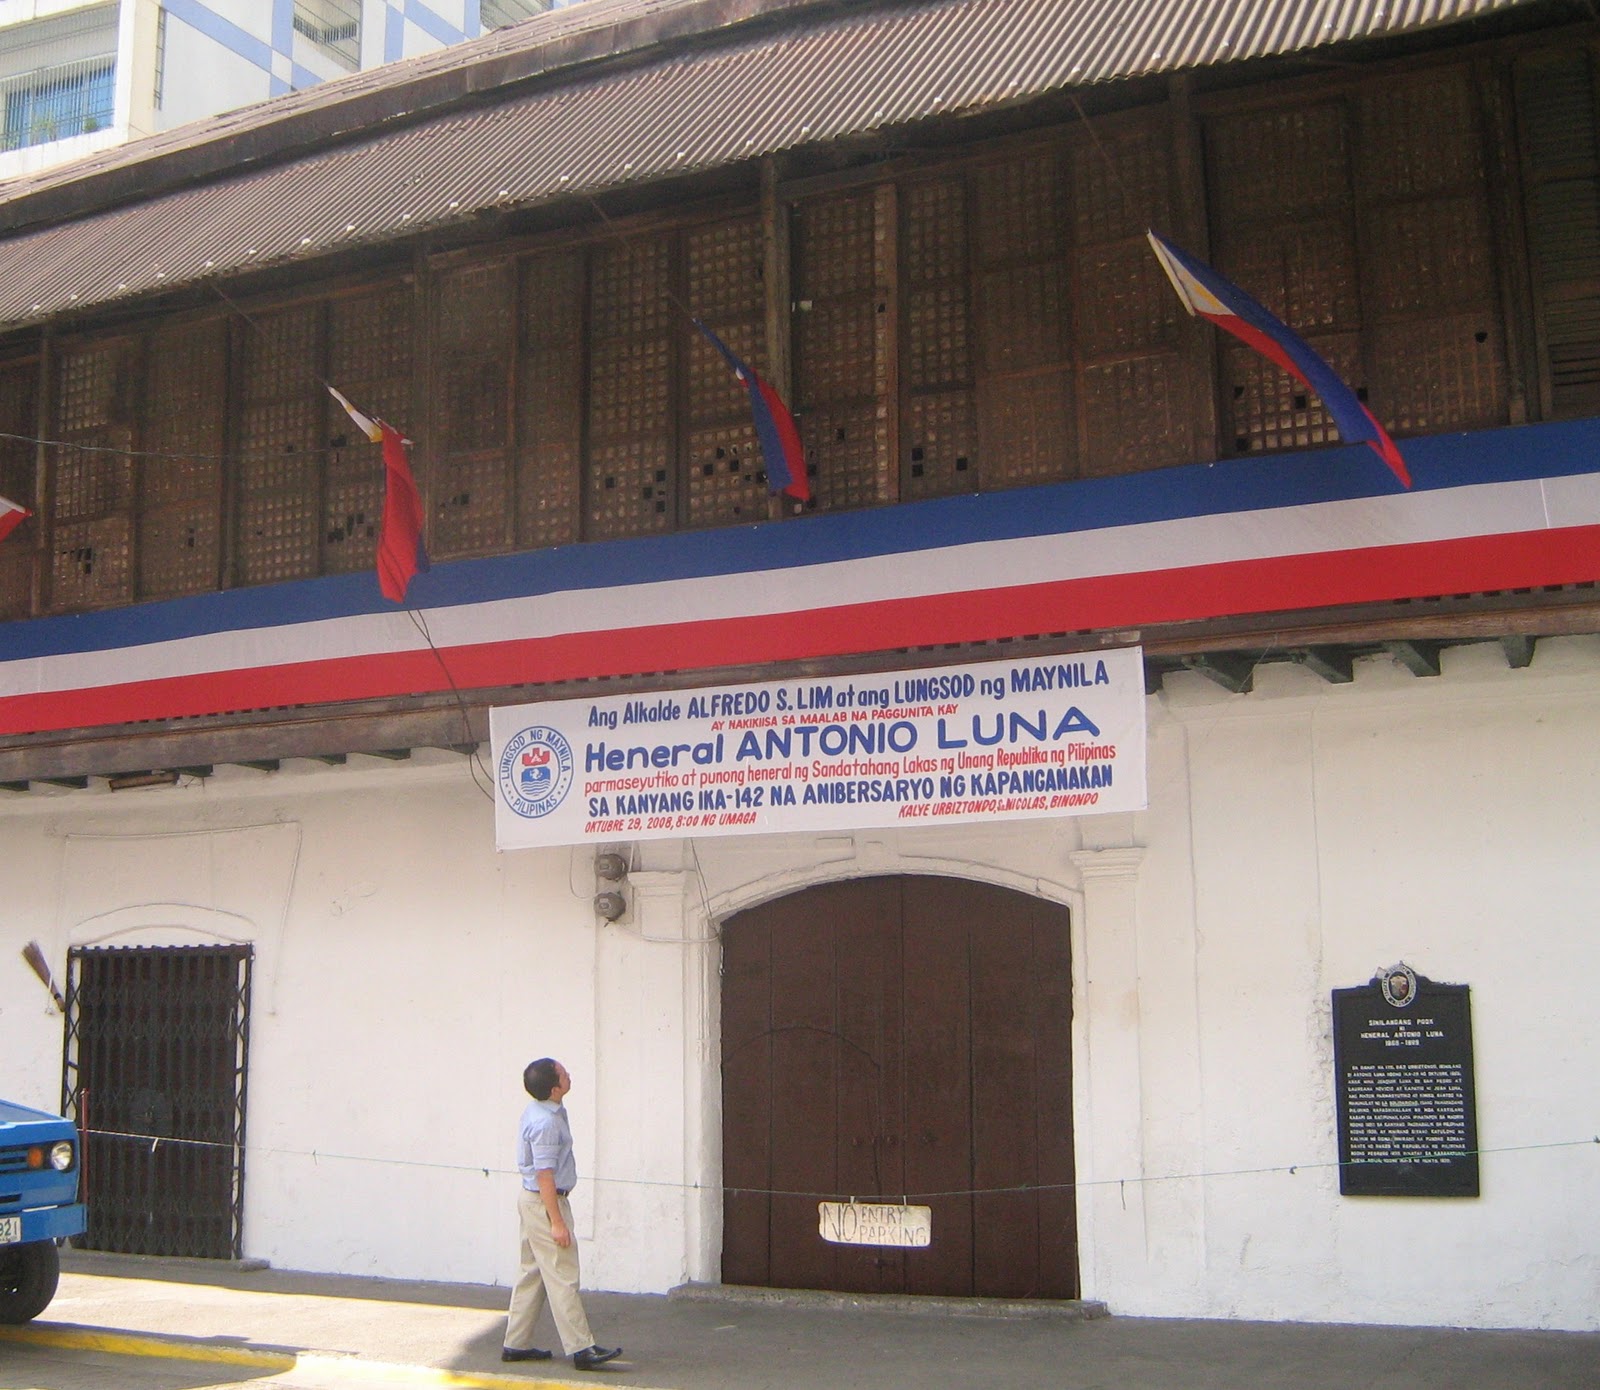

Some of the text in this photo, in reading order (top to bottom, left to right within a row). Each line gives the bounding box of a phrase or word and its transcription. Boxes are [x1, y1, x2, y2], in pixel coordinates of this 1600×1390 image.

[588, 660, 1110, 730] Ang Alkalde ALFREDO S. LIM at ang LUNGSOD ng MAYNILA
[711, 703, 959, 731] AY NAKIKIISA SA MAALAB NA PAGGUNITA KAY
[501, 729, 572, 780] LUNGSOD NG MAYNILA
[584, 706, 1101, 773] Heneral ANTONIO LUNA
[584, 742, 1117, 798] parmaseyutiko at punong heneral ng Sandatahang Lakas ng Unang Republika ng Pilipinas
[512, 795, 557, 815] PILIPINAS
[588, 764, 1113, 818] SA KANYANG IKA-142 NA ANIBERSARYO NG KAPANGANAKAN
[898, 804, 930, 818] KALYE
[1050, 792, 1099, 809] BINONDO
[584, 818, 624, 834] OKTUBRE
[627, 816, 644, 831] 29,
[701, 813, 716, 827] NG
[719, 811, 757, 826] UMAGA
[1425, 1030, 1444, 1038] LUNA
[823, 1203, 904, 1242] NO ENTRY
[860, 1226, 927, 1246] PARKING
